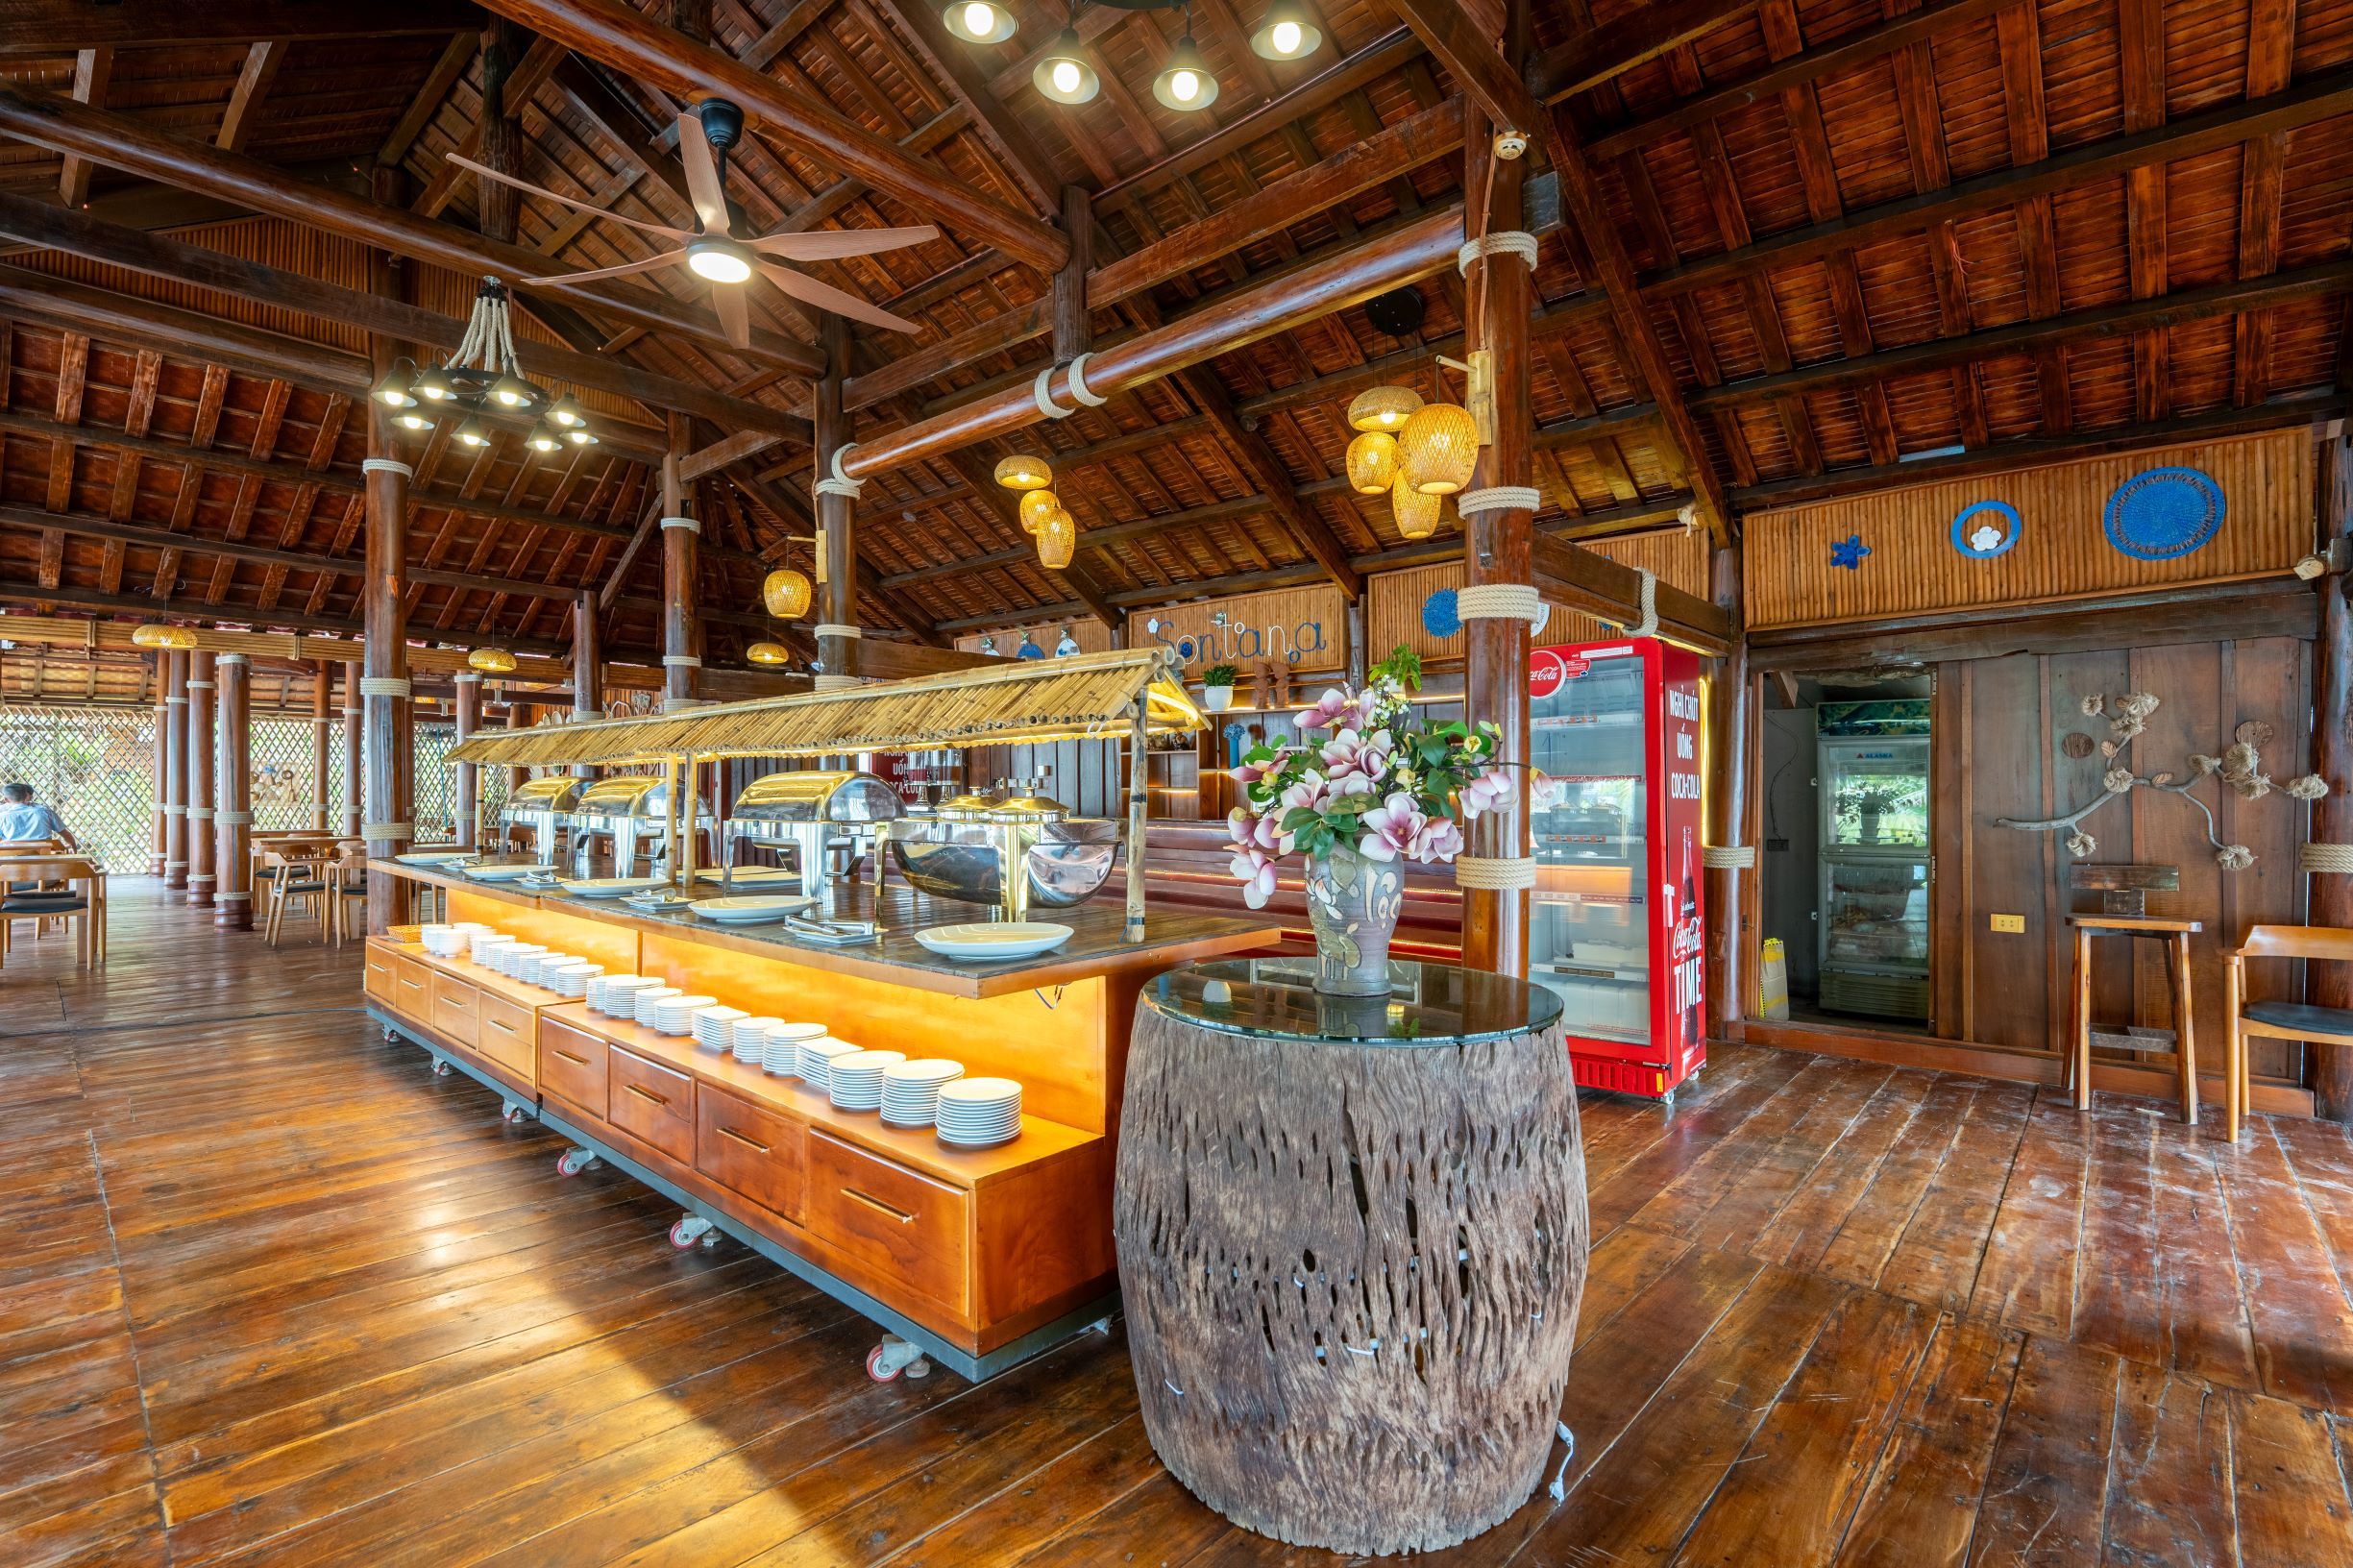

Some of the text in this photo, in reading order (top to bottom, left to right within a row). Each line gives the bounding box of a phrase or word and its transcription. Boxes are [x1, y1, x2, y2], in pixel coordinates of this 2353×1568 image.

[1669, 685, 1699, 722] NGHỈ CHÚT
[1677, 723, 1693, 760] UỐNG
[893, 757, 909, 775] UỐN
[1671, 772, 1701, 799] COCA-COLA
[1674, 956, 1703, 1016] TIME
